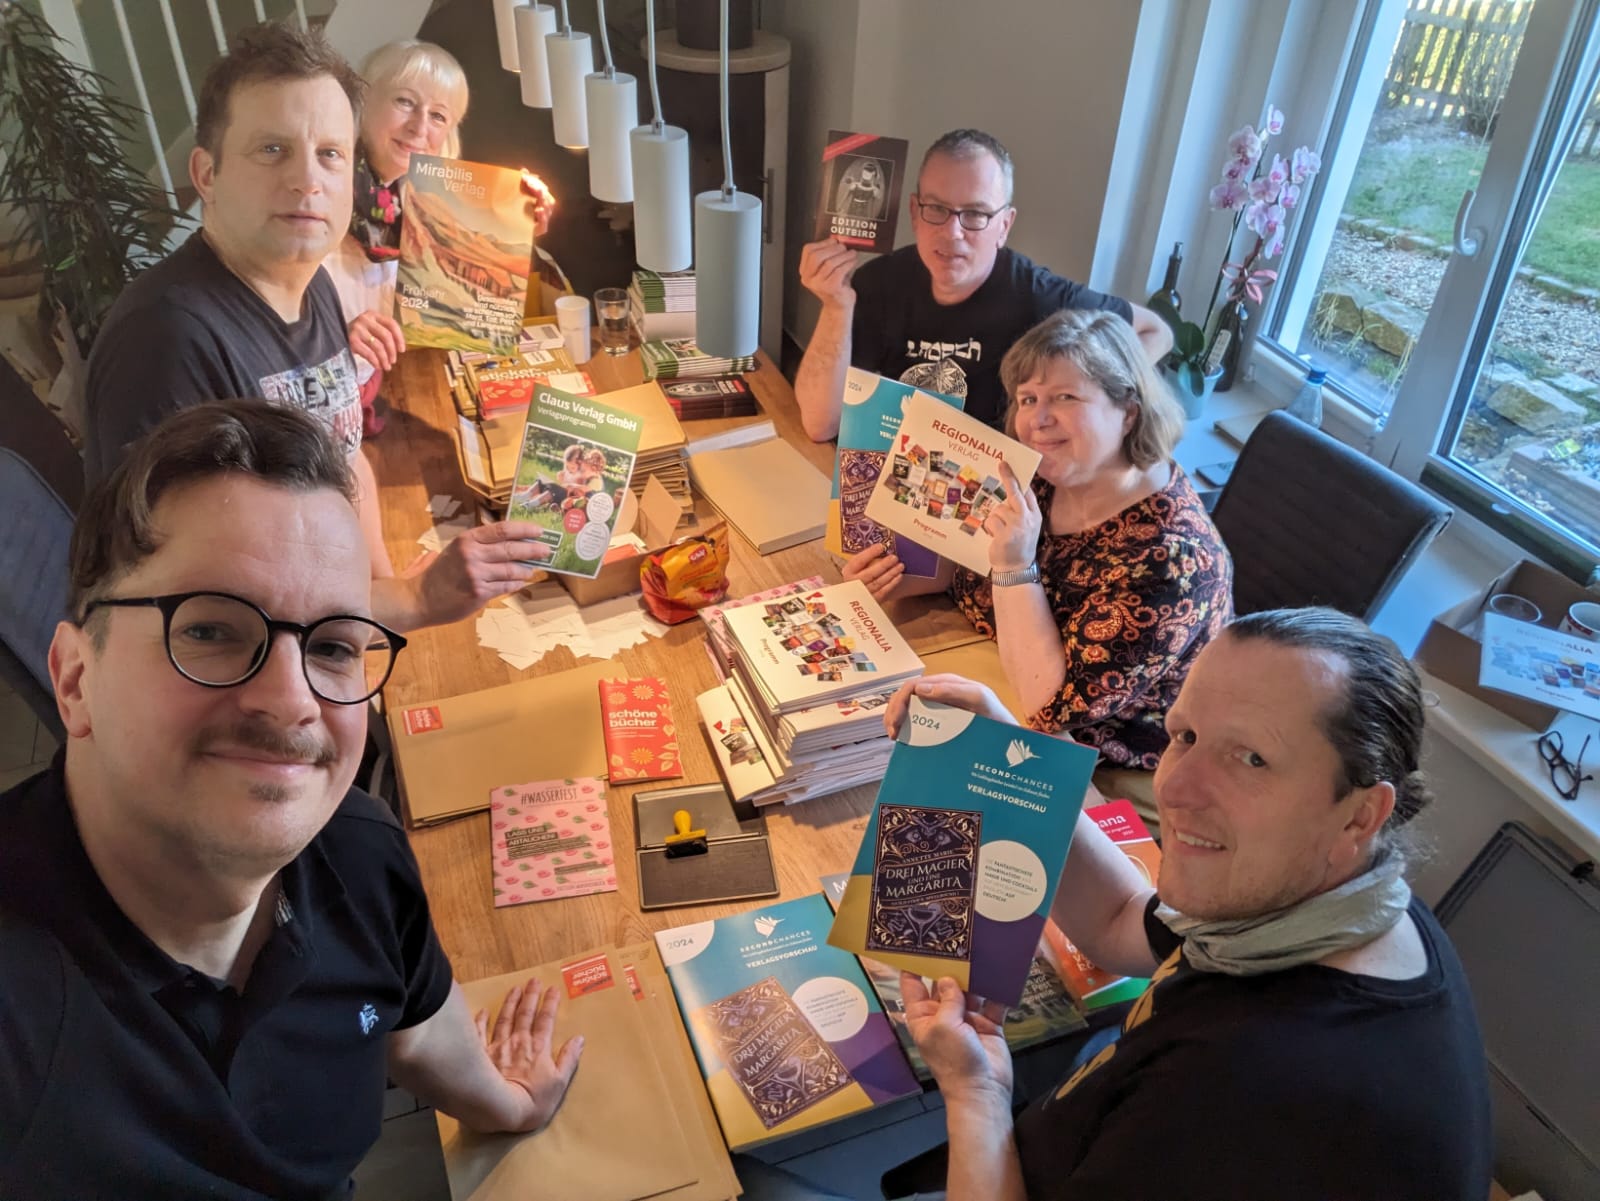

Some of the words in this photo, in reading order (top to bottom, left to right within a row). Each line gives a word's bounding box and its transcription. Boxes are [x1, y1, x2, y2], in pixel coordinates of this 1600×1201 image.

[415, 161, 473, 182] Mirabilis
[443, 178, 486, 199] Verlag
[830, 225, 877, 239] OUTBIRD
[831, 216, 878, 231] EDITION
[401, 296, 429, 310] 2024
[537, 405, 597, 430] Verlagsprogramm
[538, 391, 572, 411] Claus
[572, 401, 605, 425] Verlag
[606, 413, 638, 433] GmbH
[932, 419, 1004, 461] REGIONALIA
[947, 440, 980, 461] VERLAG
[912, 518, 947, 539] Programm
[849, 599, 893, 653] REGIONALIA
[608, 708, 658, 719] schöne
[609, 718, 657, 728] bücher
[911, 714, 941, 730] 2024
[973, 762, 1054, 791] SECONDCHANCES
[521, 787, 578, 806] #WASSERFEST
[967, 783, 1047, 814] VERLAGSVORSCHAU
[885, 867, 914, 880] DREI
[917, 858, 969, 877] MAGIER
[885, 876, 964, 899] MARGARITA
[666, 938, 695, 950] 2024
[733, 1042, 759, 1065] DREI
[755, 1012, 796, 1047] MAGIER
[743, 1027, 803, 1079] MARGARITA
